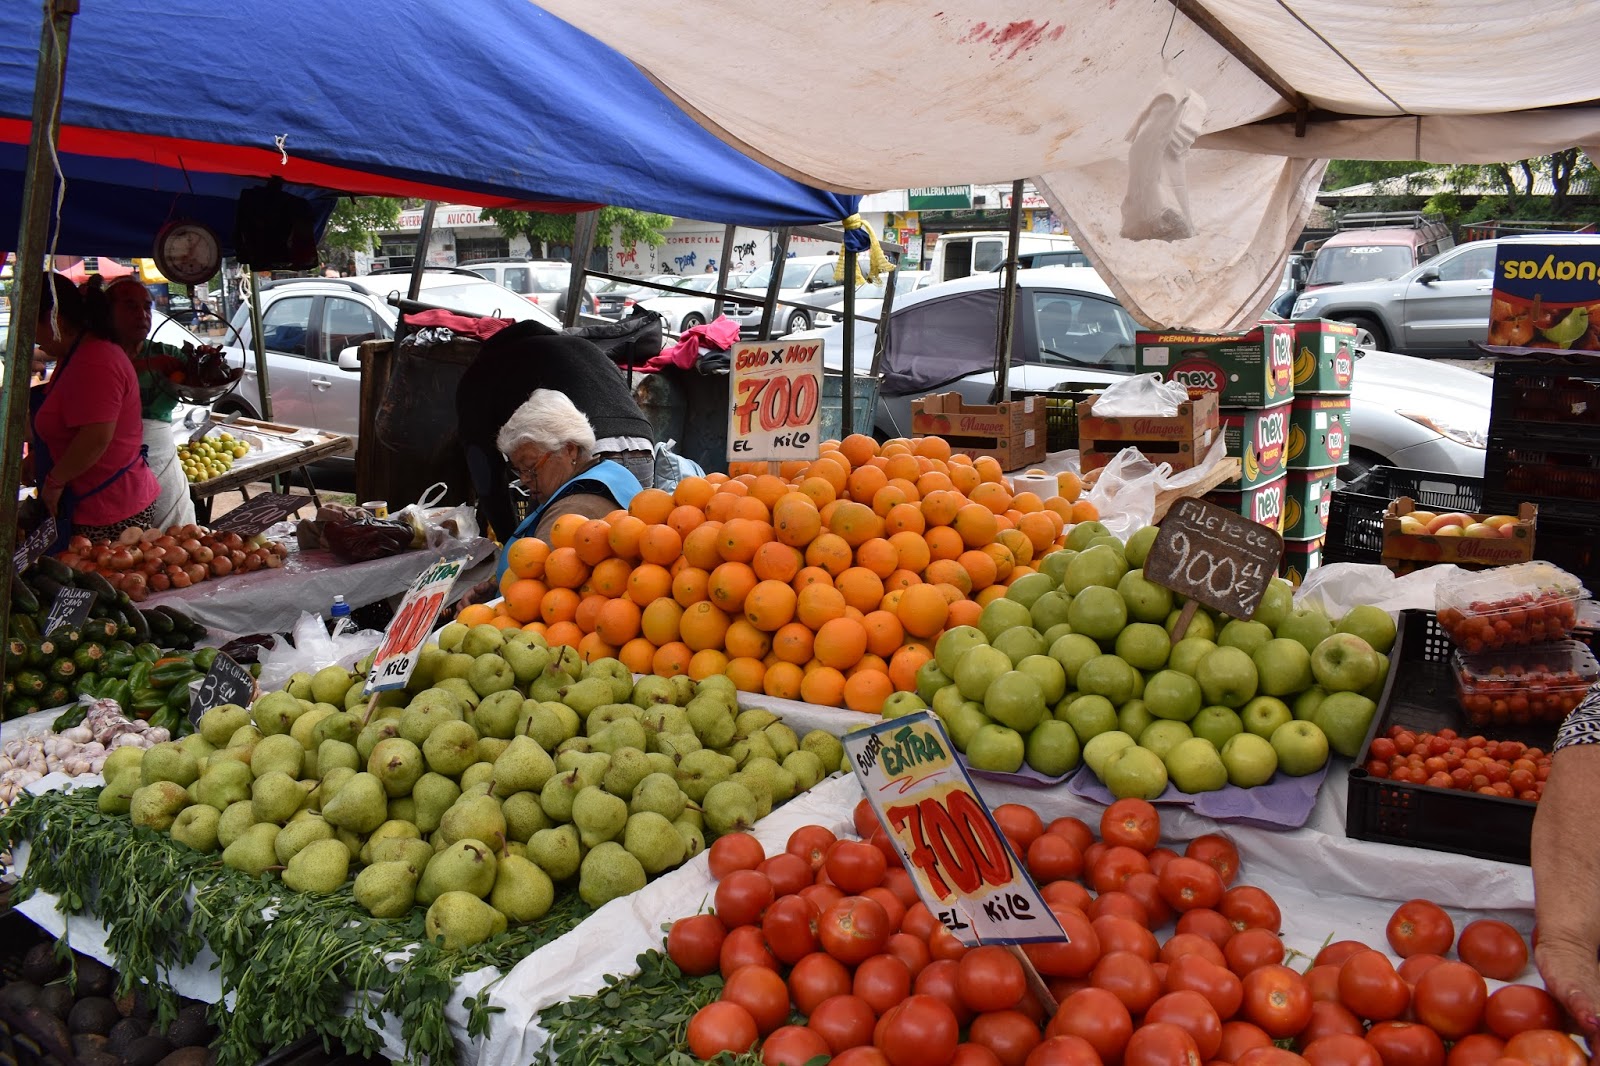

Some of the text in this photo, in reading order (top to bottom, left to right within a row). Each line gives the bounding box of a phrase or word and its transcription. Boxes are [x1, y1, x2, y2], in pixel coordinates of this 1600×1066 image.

[910, 185, 970, 197] BOTILLERIA DANNY
[1503, 254, 1600, 286] uayas
[1158, 335, 1196, 343] PREMIUM
[1173, 371, 1218, 388] nex
[960, 416, 1005, 434] Mangoes
[1133, 420, 1185, 435] Mangoes
[1258, 412, 1284, 449] nex
[733, 440, 753, 452] EL
[1255, 487, 1280, 523] nex
[1456, 538, 1523, 562] Mangoes
[1168, 531, 1238, 598] 900
[58, 587, 91, 599] ITALIANO
[62, 598, 83, 607] SANO
[219, 681, 237, 702] EN
[857, 725, 947, 777] SUPER EXTRA
[938, 909, 969, 931] EL
